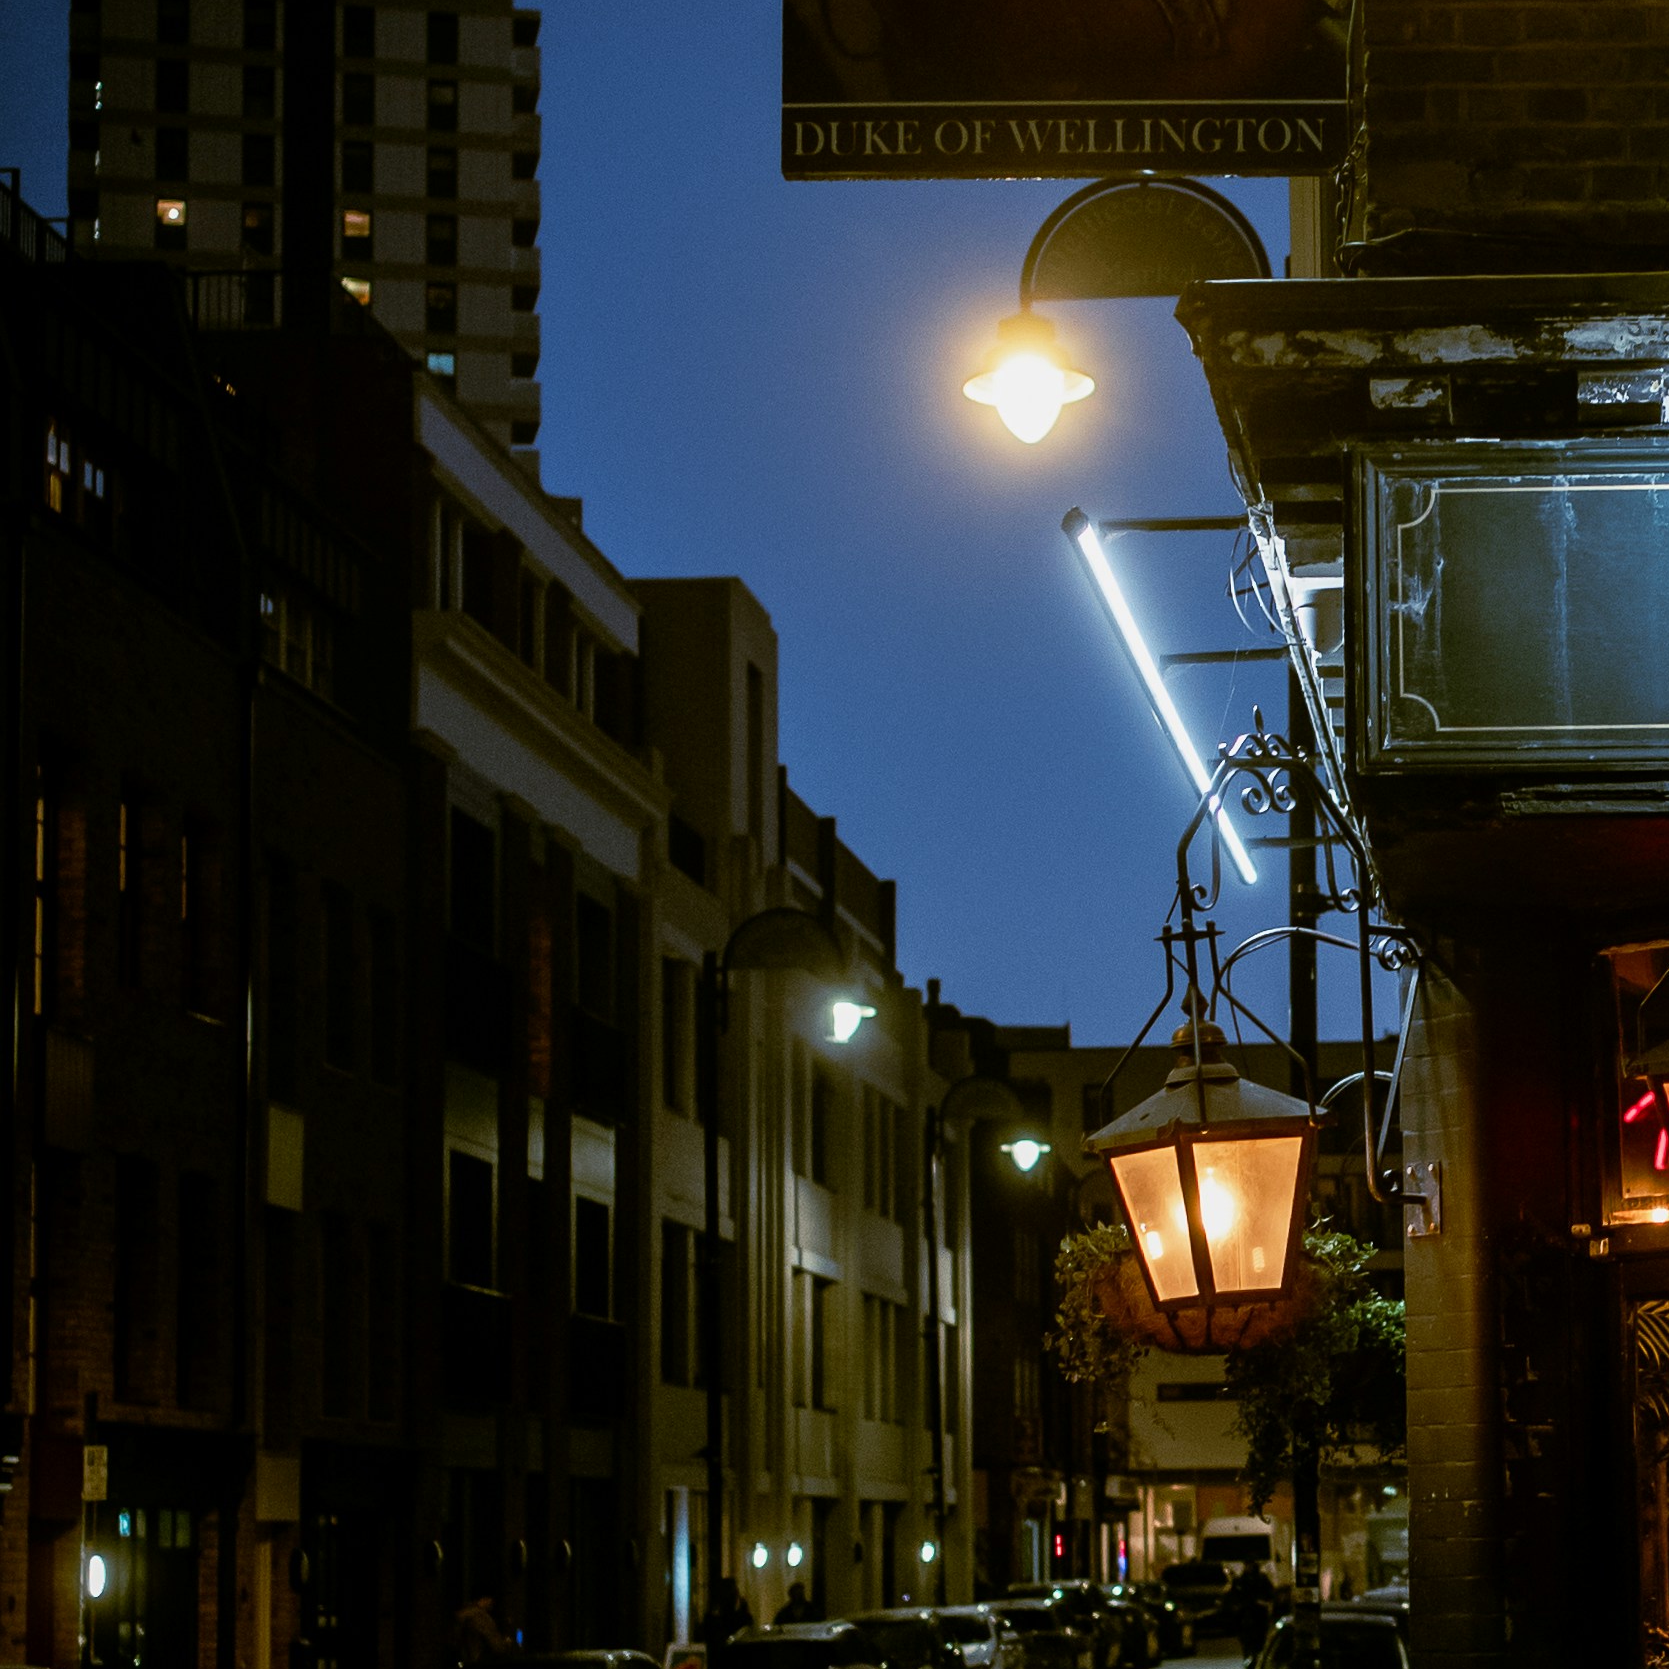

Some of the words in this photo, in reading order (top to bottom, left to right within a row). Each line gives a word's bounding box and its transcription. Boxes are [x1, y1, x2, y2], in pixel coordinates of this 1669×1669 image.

[793, 119, 922, 156] DUKE
[934, 119, 1000, 155] OF
[1009, 117, 1326, 155] WELLINGTON
